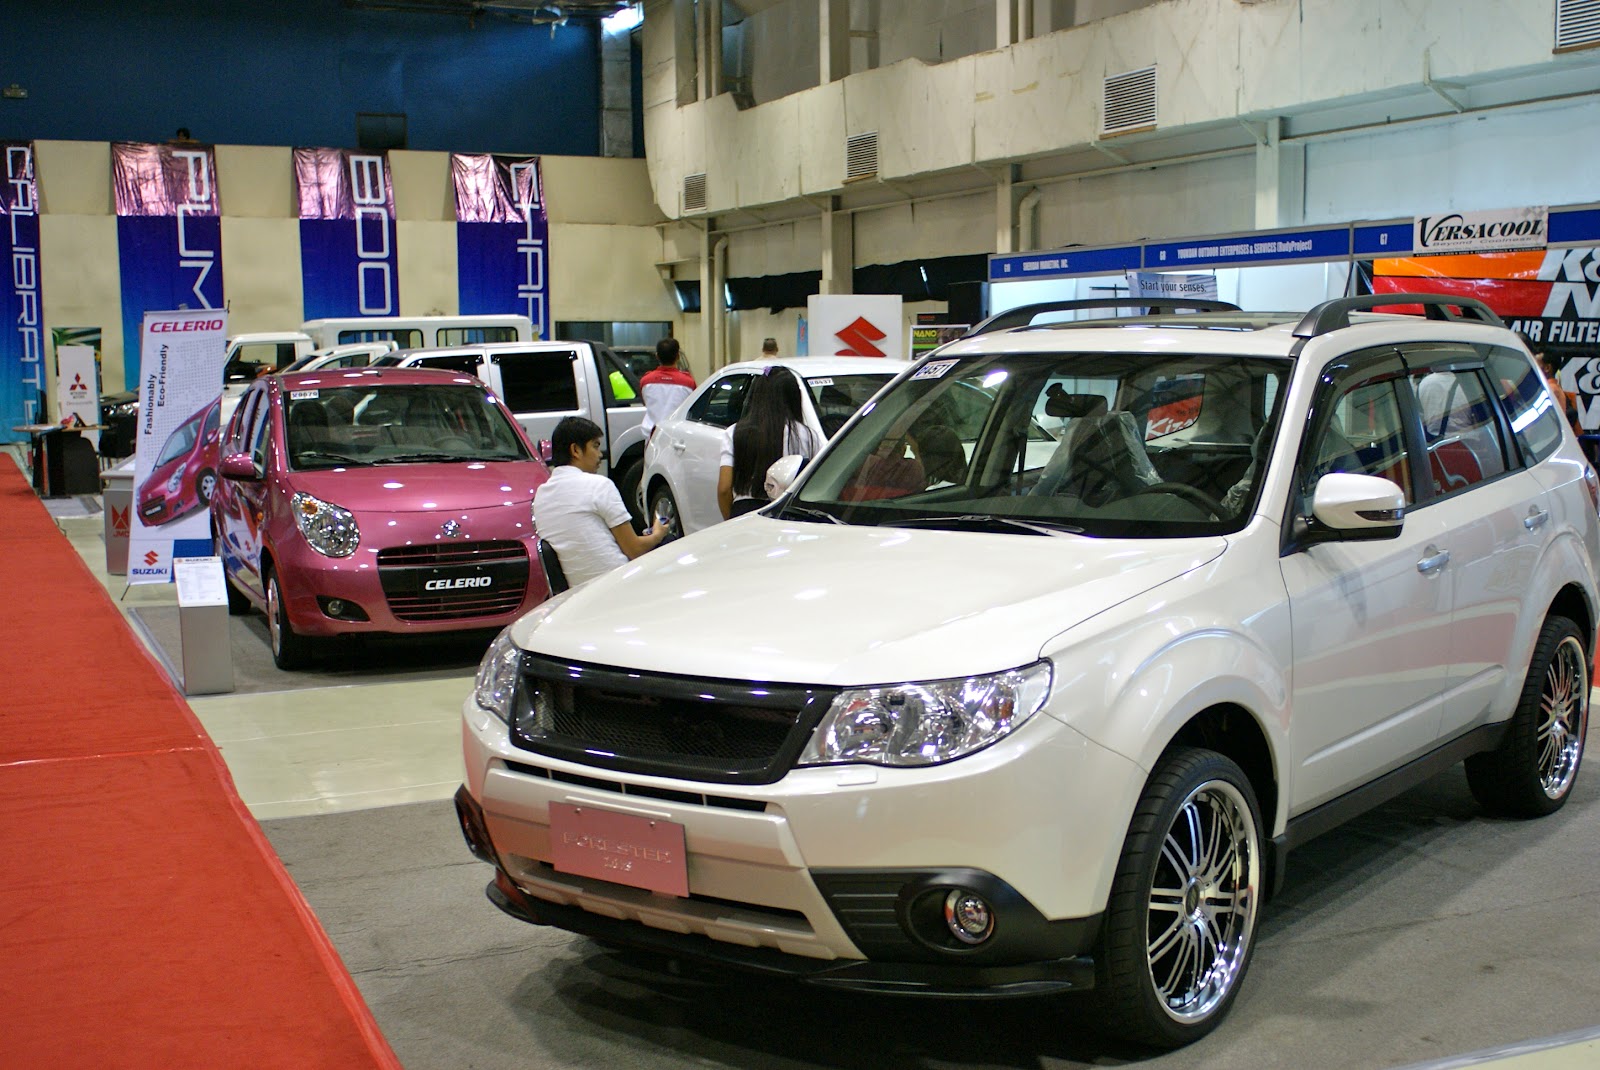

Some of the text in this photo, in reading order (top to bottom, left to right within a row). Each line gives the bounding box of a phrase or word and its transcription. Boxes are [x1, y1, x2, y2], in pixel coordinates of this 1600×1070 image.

[1417, 214, 1544, 248] VERSACOOL
[1220, 244, 1249, 256] ENTERPRISES
[1254, 242, 1276, 254] SERVICES
[1141, 280, 1207, 293] Start your senses.
[150, 319, 223, 333] CELERIO
[1548, 320, 1600, 343] FILTE
[913, 330, 937, 338] NANO
[158, 344, 169, 407] Eco-Friendly
[145, 373, 157, 435] Fashionably
[425, 576, 492, 590] CELERIO
